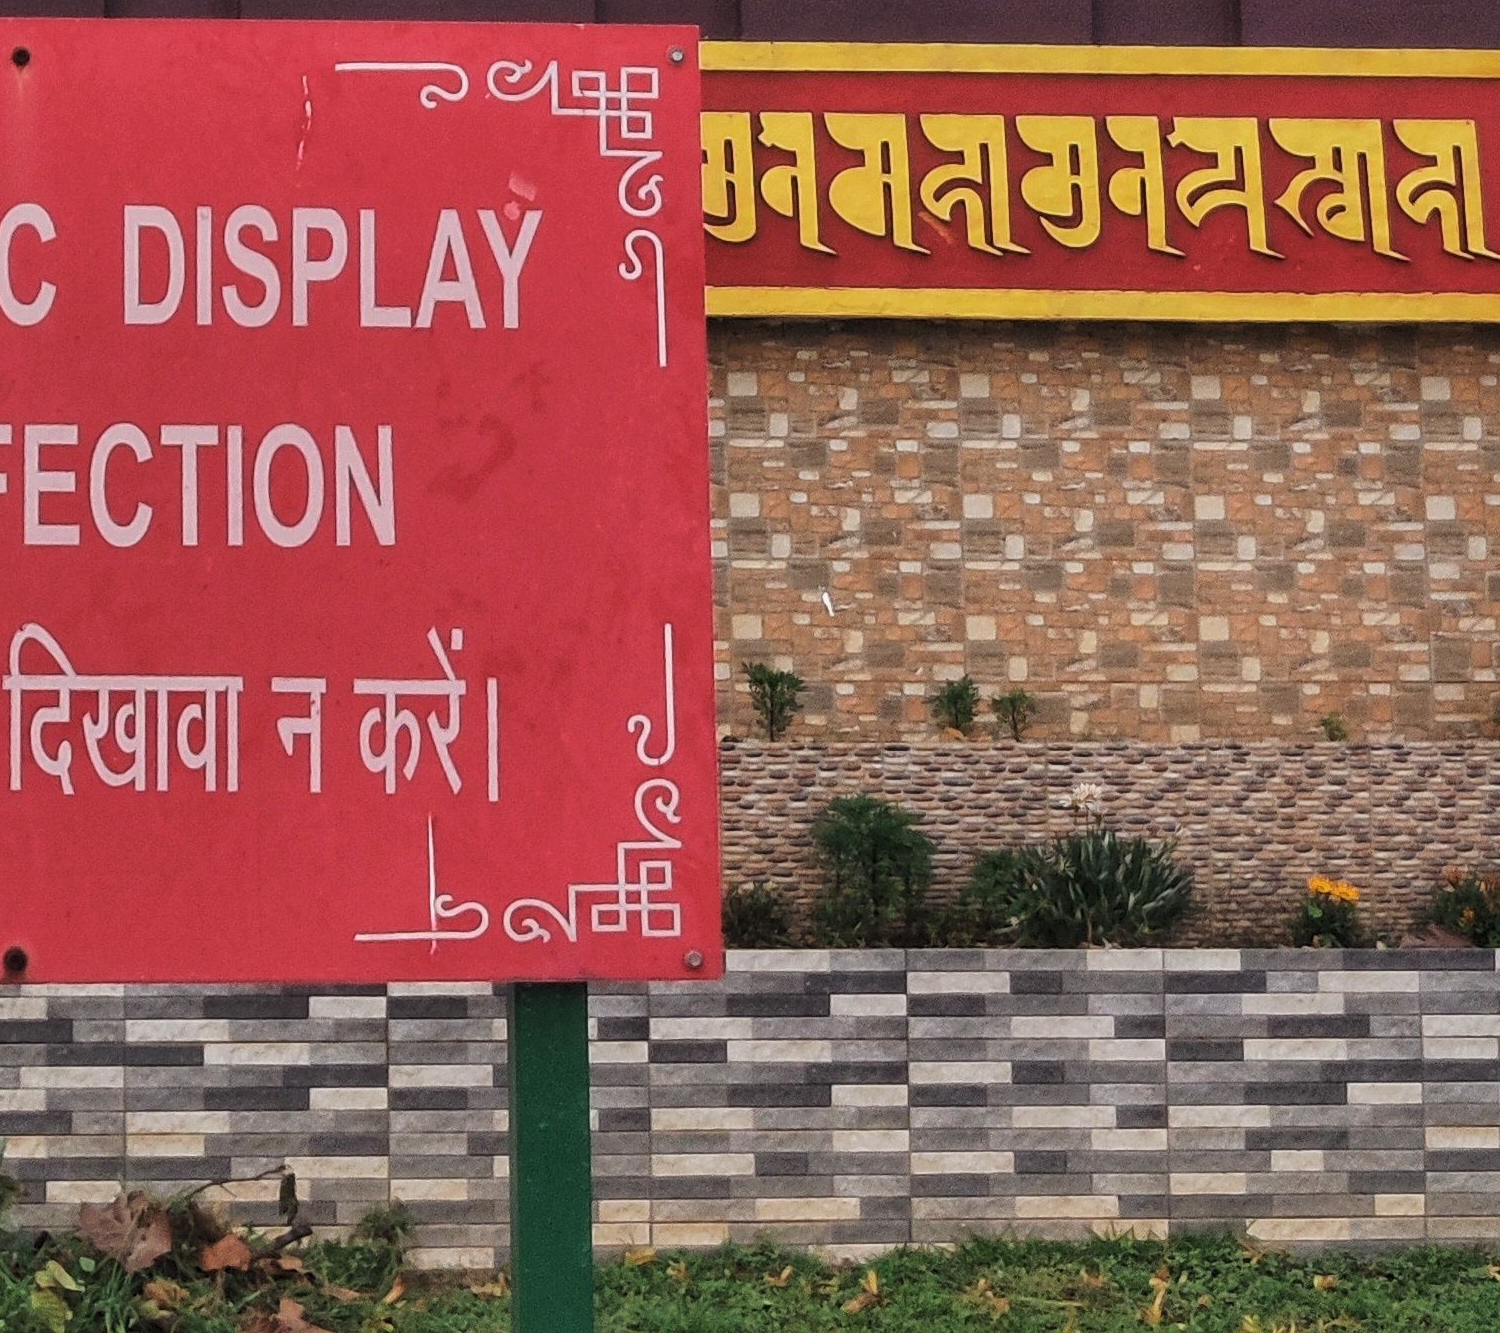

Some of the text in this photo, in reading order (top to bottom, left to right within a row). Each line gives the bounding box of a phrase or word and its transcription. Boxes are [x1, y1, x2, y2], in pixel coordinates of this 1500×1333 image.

[122, 204, 543, 329] DISPLAY
[2, 622, 244, 795] दिखावा
[271, 676, 328, 794] न
